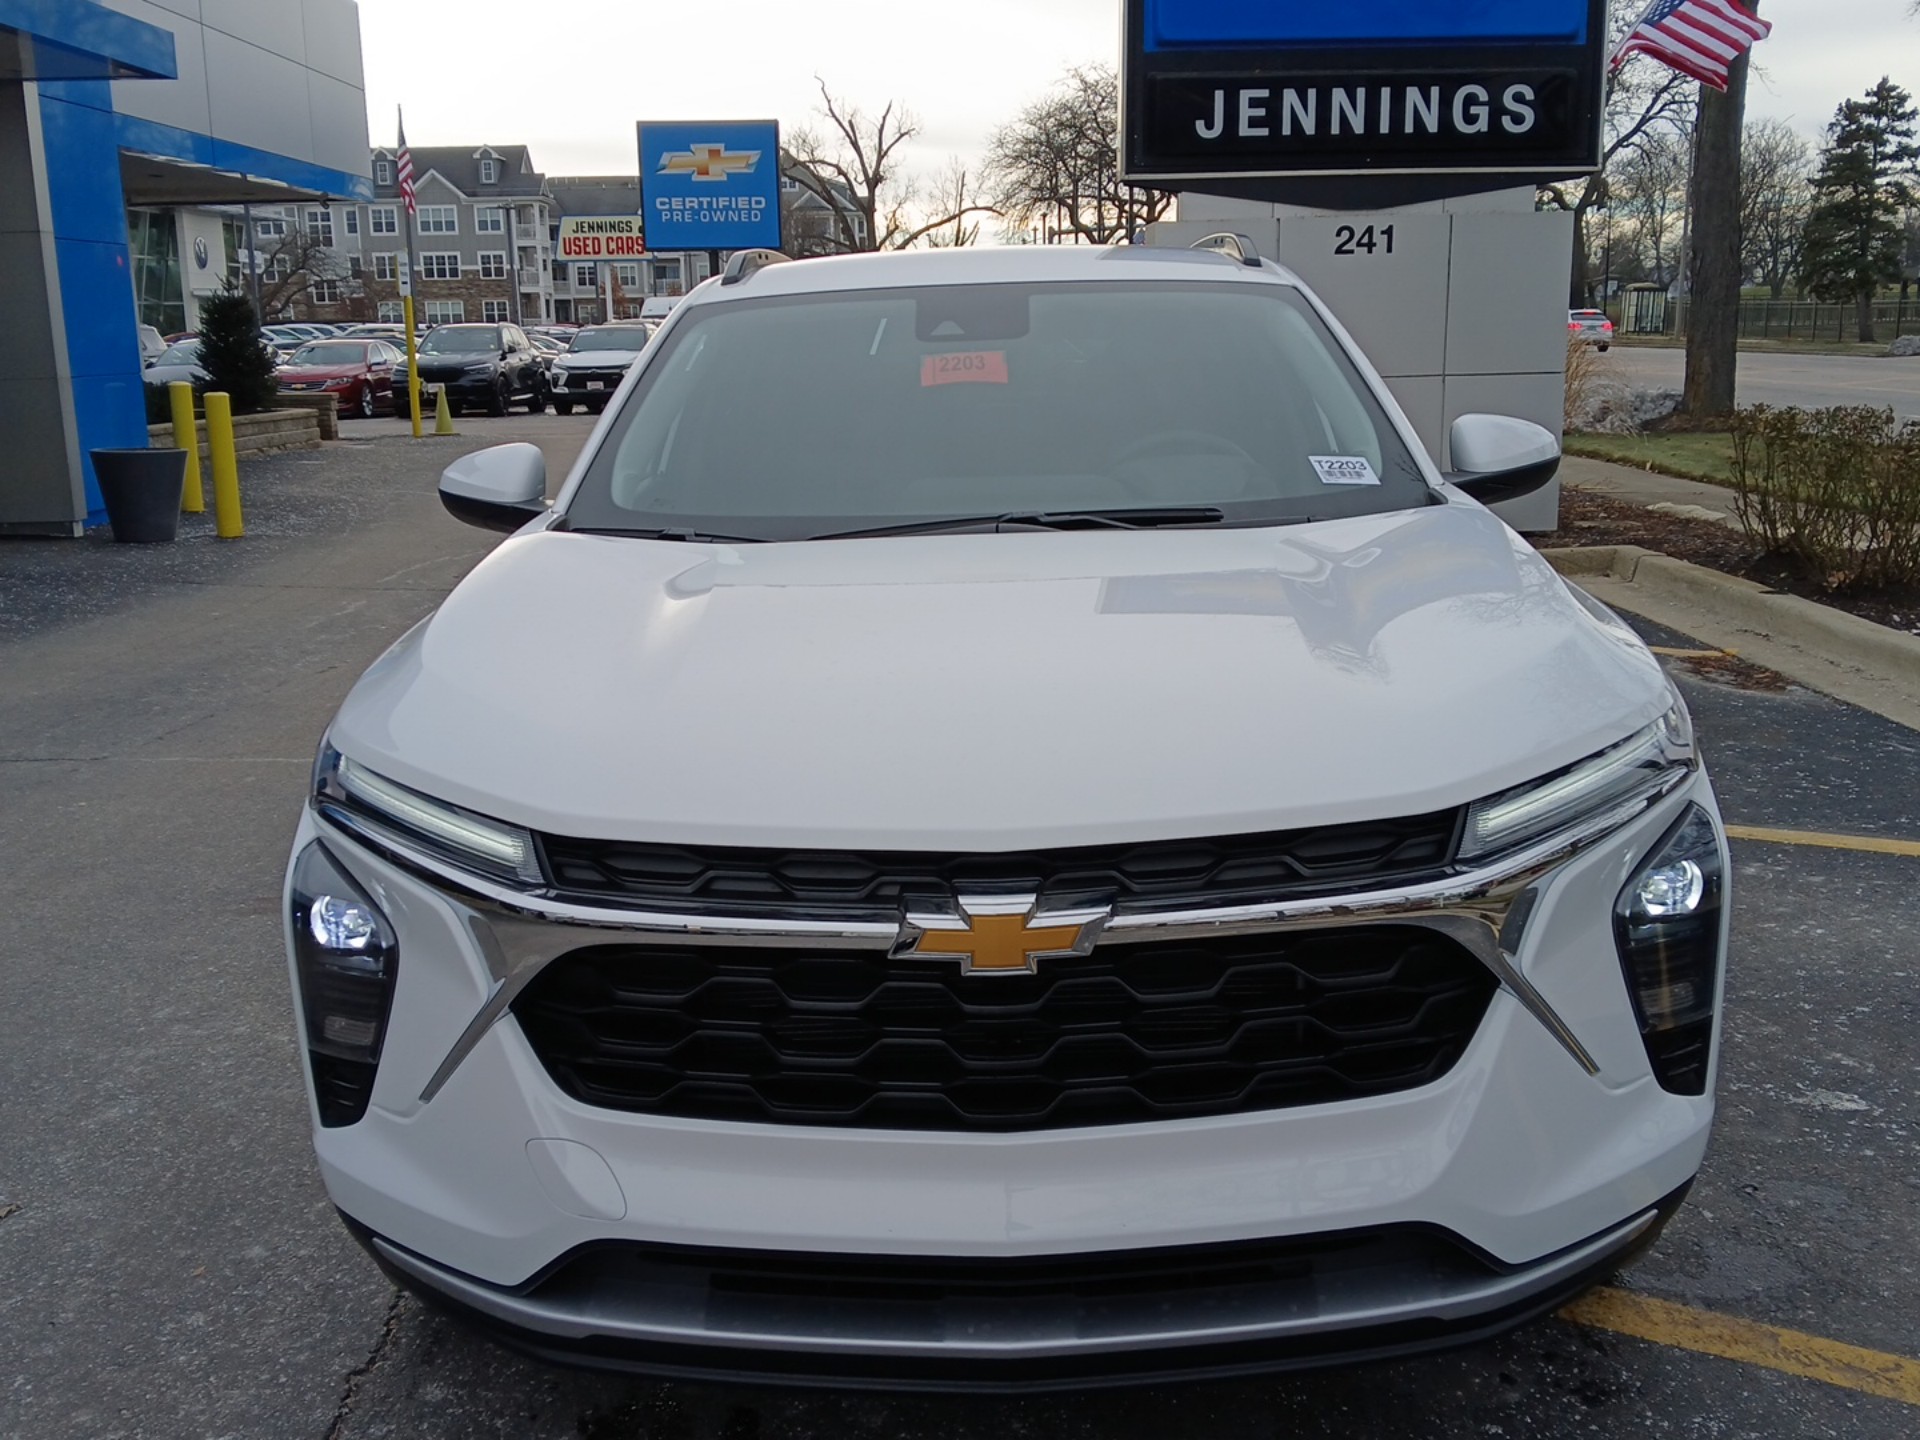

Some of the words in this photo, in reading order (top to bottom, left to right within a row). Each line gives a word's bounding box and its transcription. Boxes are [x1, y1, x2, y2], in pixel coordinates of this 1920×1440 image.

[1195, 83, 1536, 140] JENNINGS
[655, 196, 766, 210] CERTIFIED
[662, 210, 761, 222] PRE-OWNED
[572, 220, 633, 234] JENNINGS
[562, 236, 601, 256] USED
[606, 235, 645, 255] CARS
[1334, 223, 1395, 256] 241
[939, 355, 985, 372] 2203
[1314, 460, 1367, 471] T2203
